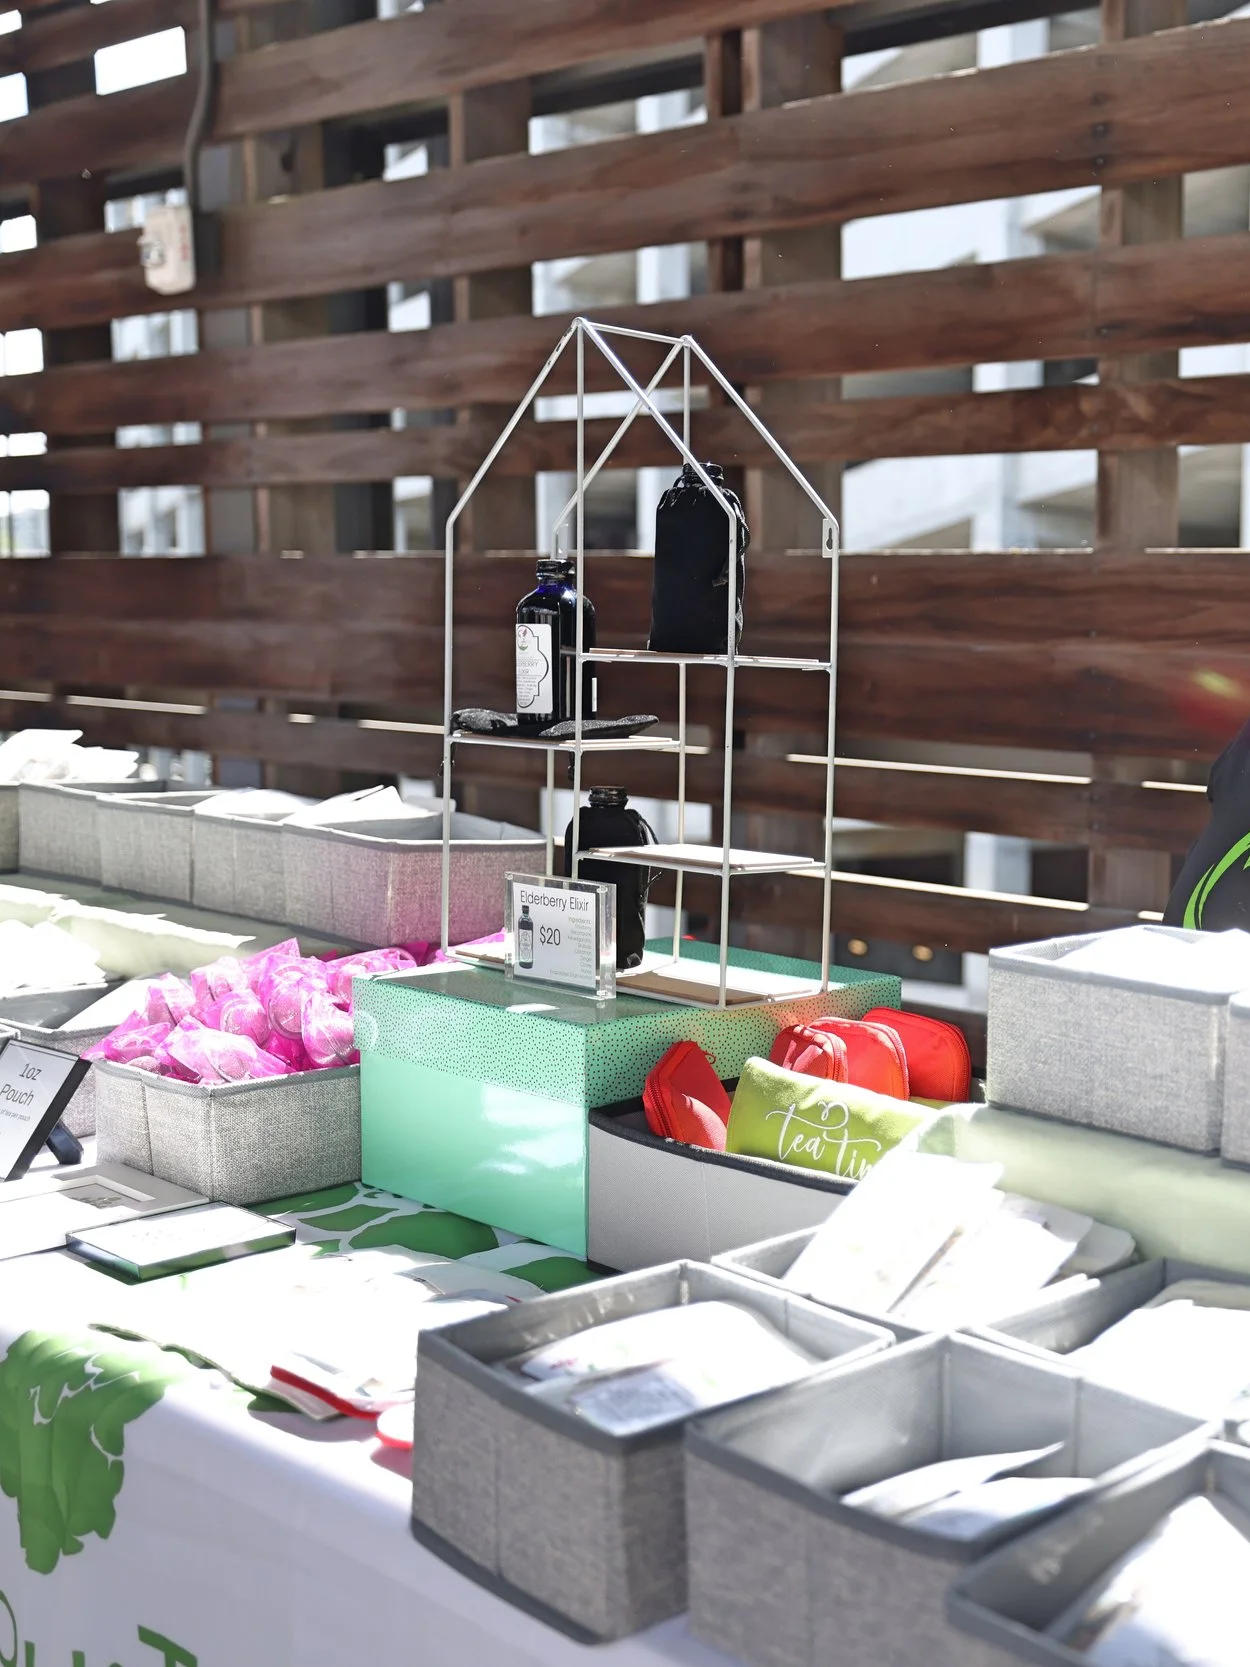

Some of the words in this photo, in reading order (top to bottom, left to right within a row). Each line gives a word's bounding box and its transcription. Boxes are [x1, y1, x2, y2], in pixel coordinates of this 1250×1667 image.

[520, 890, 567, 912] Elderberry
[570, 896, 589, 912] Elixir
[539, 925, 561, 946] $20
[0, 1083, 35, 1106] Pouch
